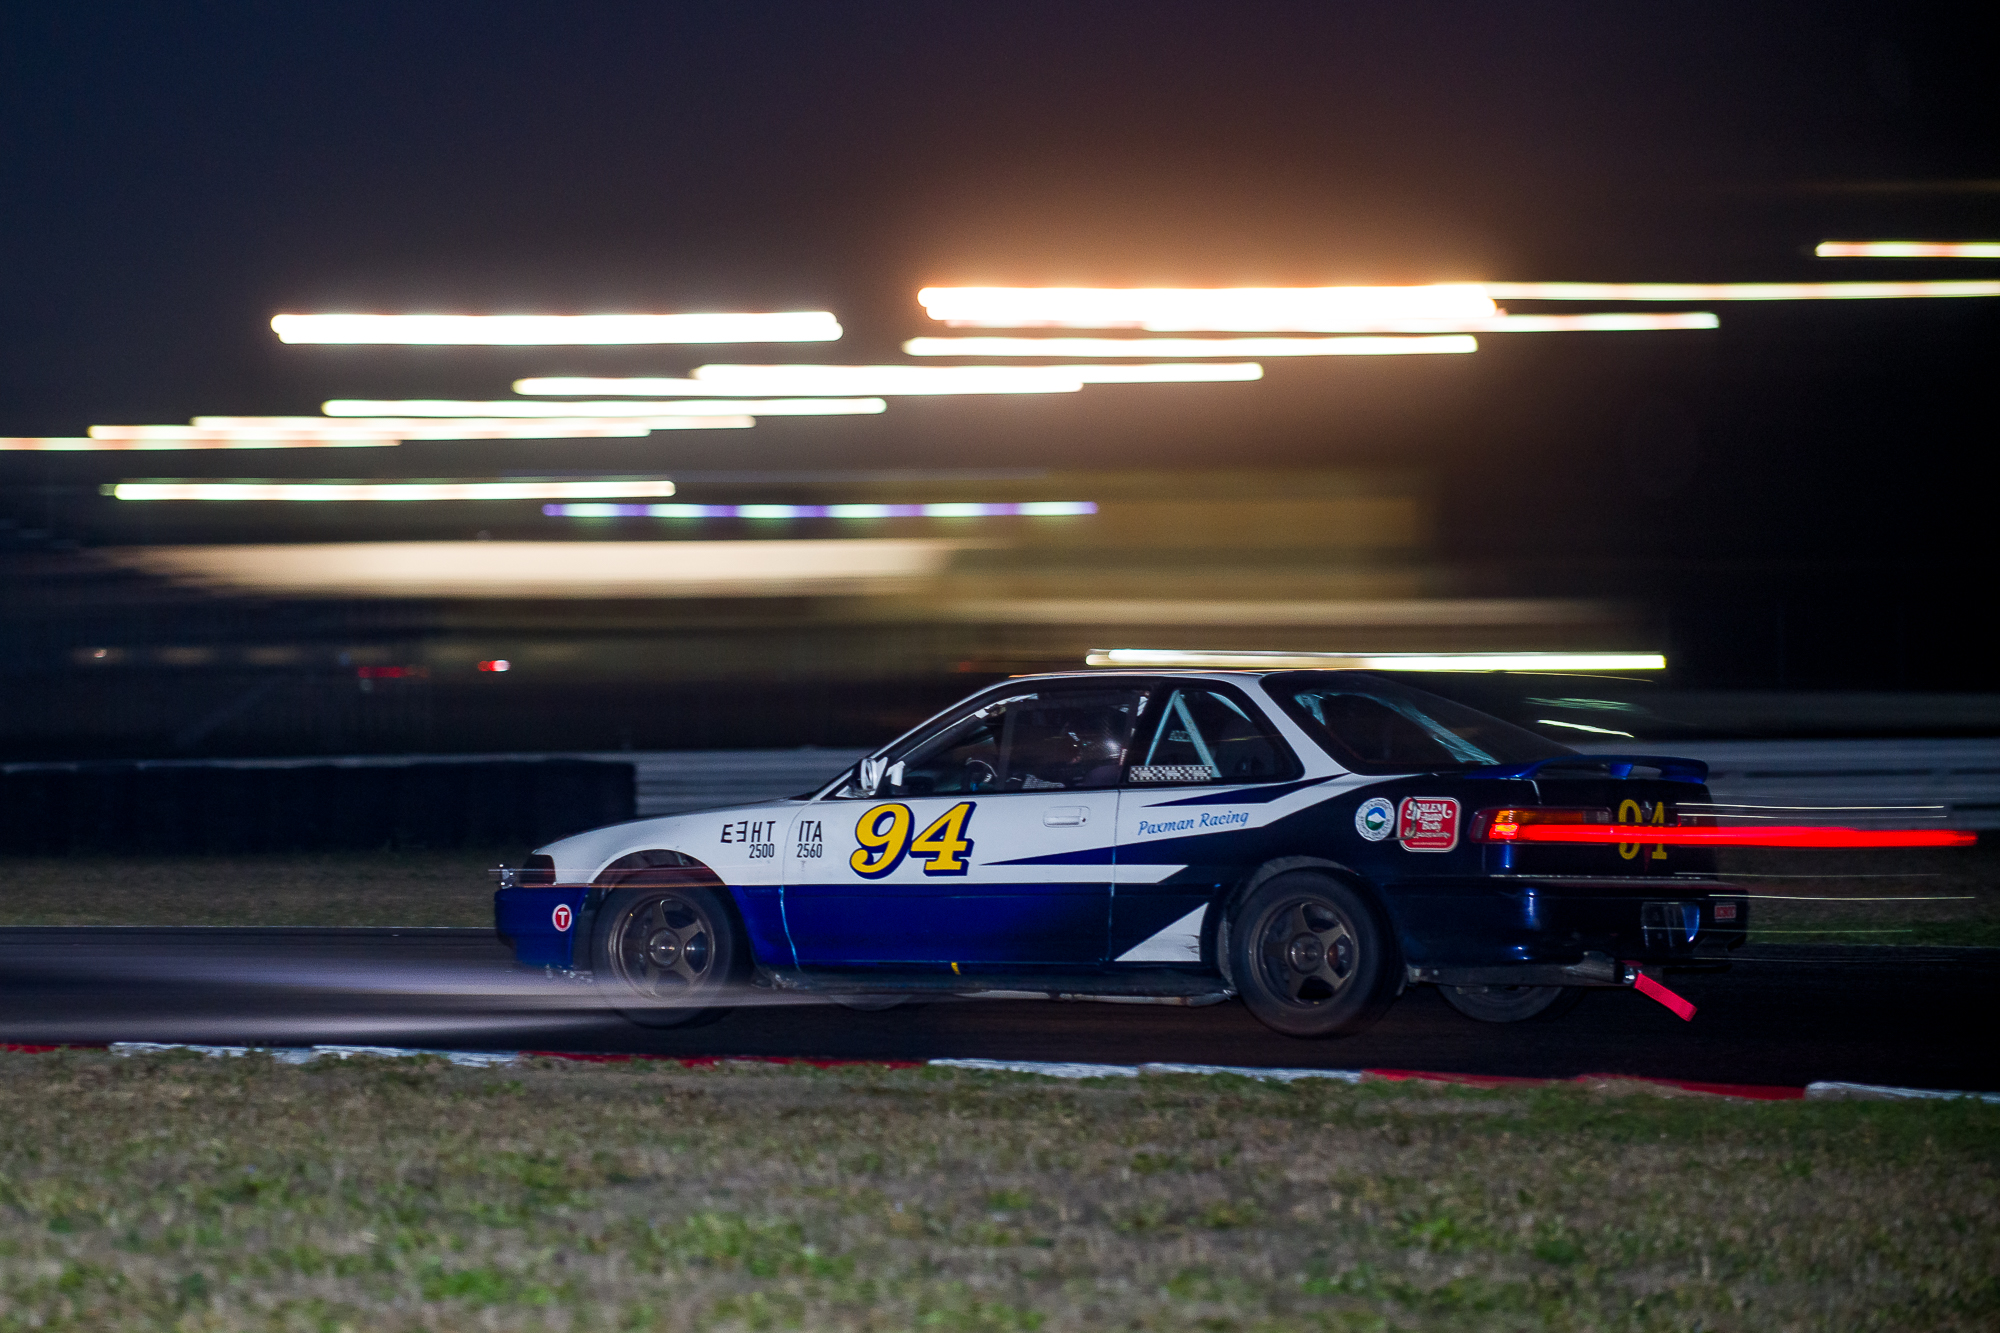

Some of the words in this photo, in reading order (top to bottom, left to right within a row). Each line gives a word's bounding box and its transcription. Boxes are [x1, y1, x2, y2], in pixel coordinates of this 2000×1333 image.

[798, 820, 823, 842] ITA
[1138, 818, 1194, 836] Paxman
[1200, 810, 1249, 827] Racing
[849, 801, 977, 880] 94
[749, 843, 775, 858] 2500
[796, 843, 823, 858] 2560
[557, 911, 568, 926] T
